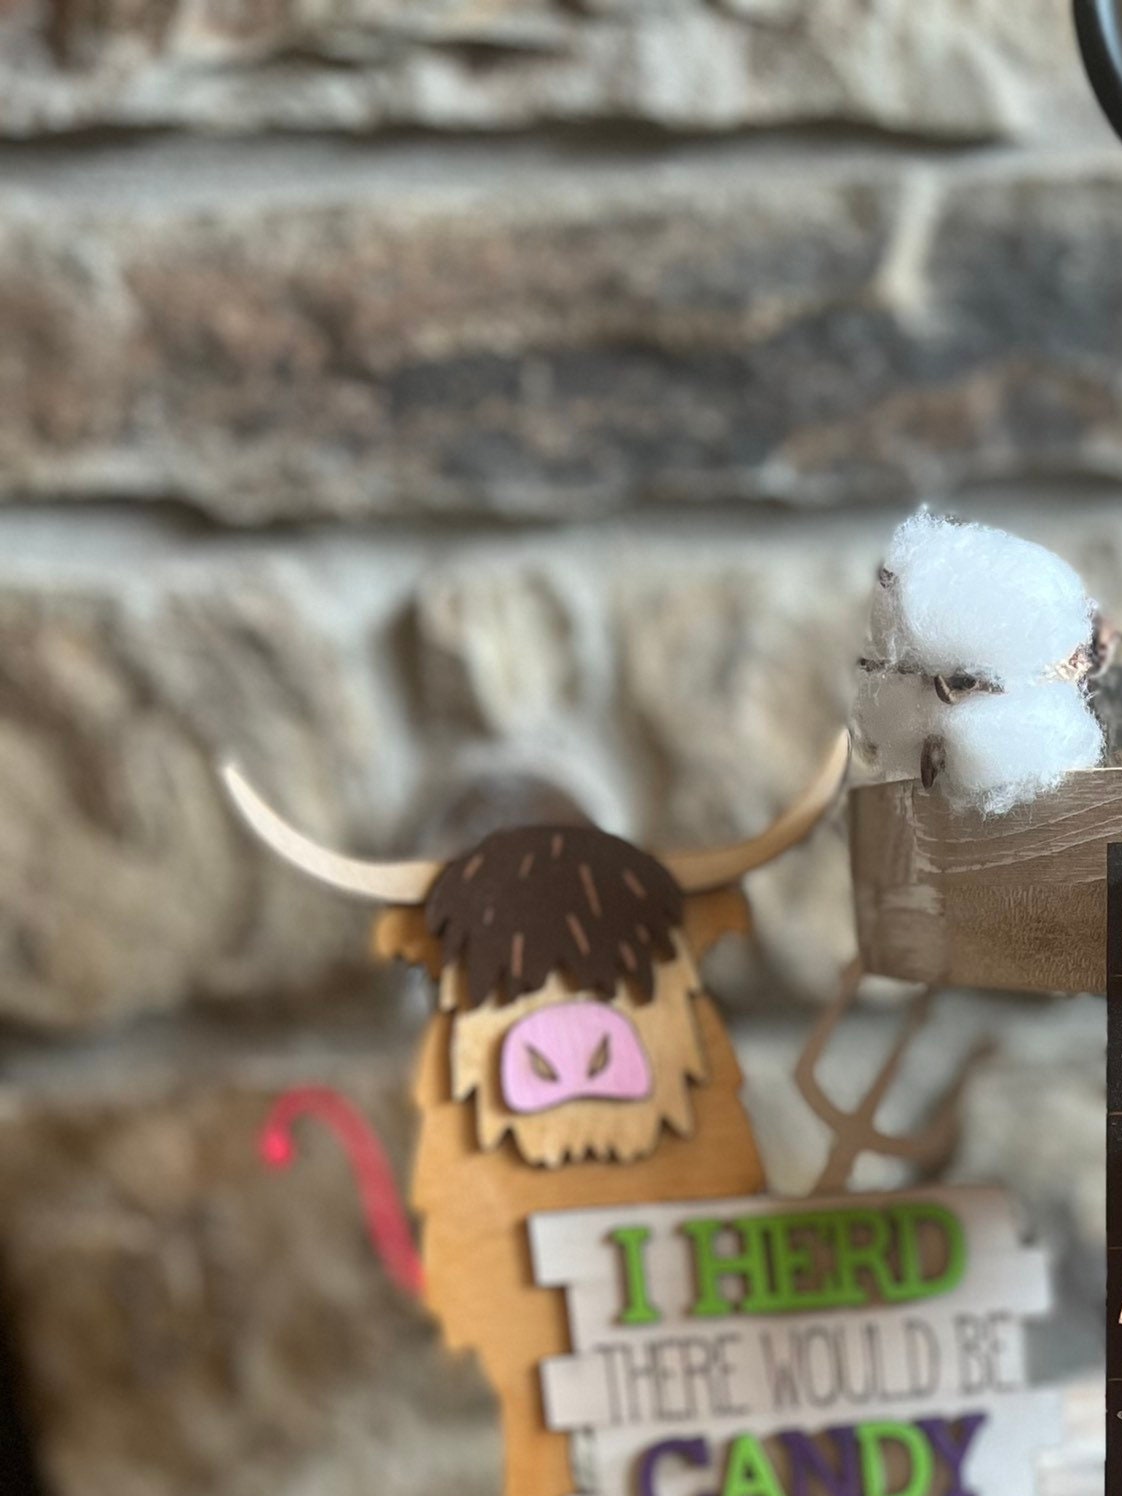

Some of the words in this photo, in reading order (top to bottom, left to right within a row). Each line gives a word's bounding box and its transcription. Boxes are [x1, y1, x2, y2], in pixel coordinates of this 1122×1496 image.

[608, 1225, 660, 1325] I
[681, 1205, 968, 1316] HERD
[596, 1334, 746, 1426] THERE
[759, 1318, 942, 1410] WOULD
[954, 1311, 1024, 1397] BE
